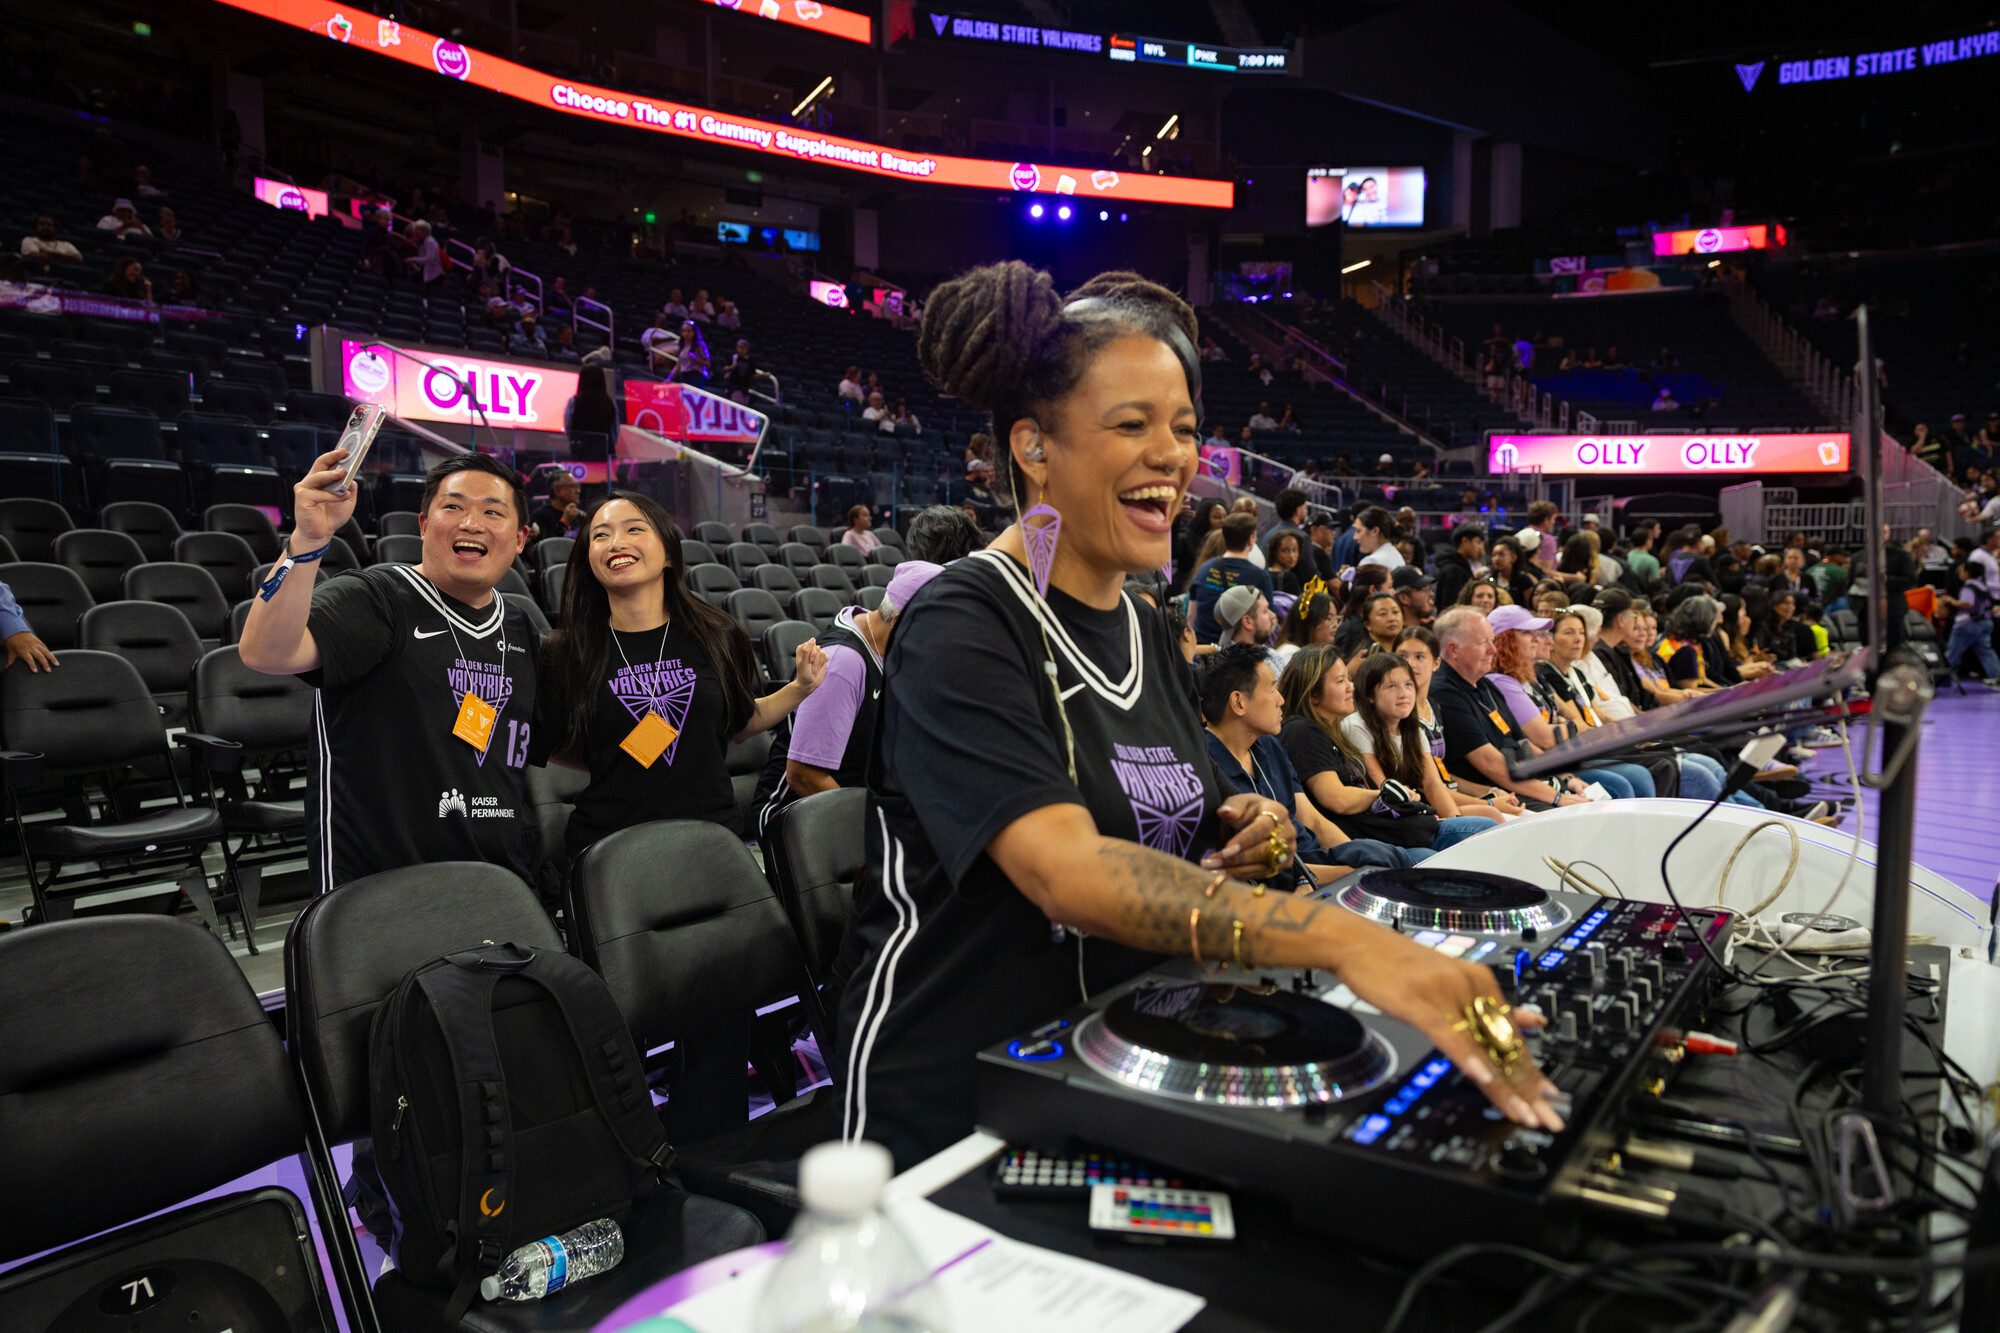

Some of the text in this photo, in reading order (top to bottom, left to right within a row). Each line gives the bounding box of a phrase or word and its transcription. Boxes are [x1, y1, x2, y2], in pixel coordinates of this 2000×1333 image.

[952, 18, 999, 41] GOLDEN
[1001, 24, 1040, 45] STATE
[1041, 29, 1102, 53] VALKYRIES
[438, 48, 463, 62] OLLY
[1266, 55, 1285, 67] PM
[1779, 56, 1850, 84] GOLDEN
[1854, 47, 1918, 77] STATE
[551, 84, 629, 118] Choose
[632, 101, 671, 126] The
[674, 110, 697, 131] #1
[700, 115, 772, 148] Gummy
[774, 130, 878, 167] Supplement
[424, 365, 536, 416] OLLY
[1577, 442, 1646, 466] OLLY
[1685, 442, 1755, 465] OLLY
[455, 658, 482, 671] GODEN
[617, 658, 683, 677] GOLDEN STATE
[608, 667, 697, 696] VALKYRIES
[506, 719, 531, 769] 13
[1144, 746, 1178, 763] STATE
[1110, 758, 1204, 812] VALKYRIES
[471, 796, 498, 806] KAISER
[120, 1276, 155, 1306] 71
